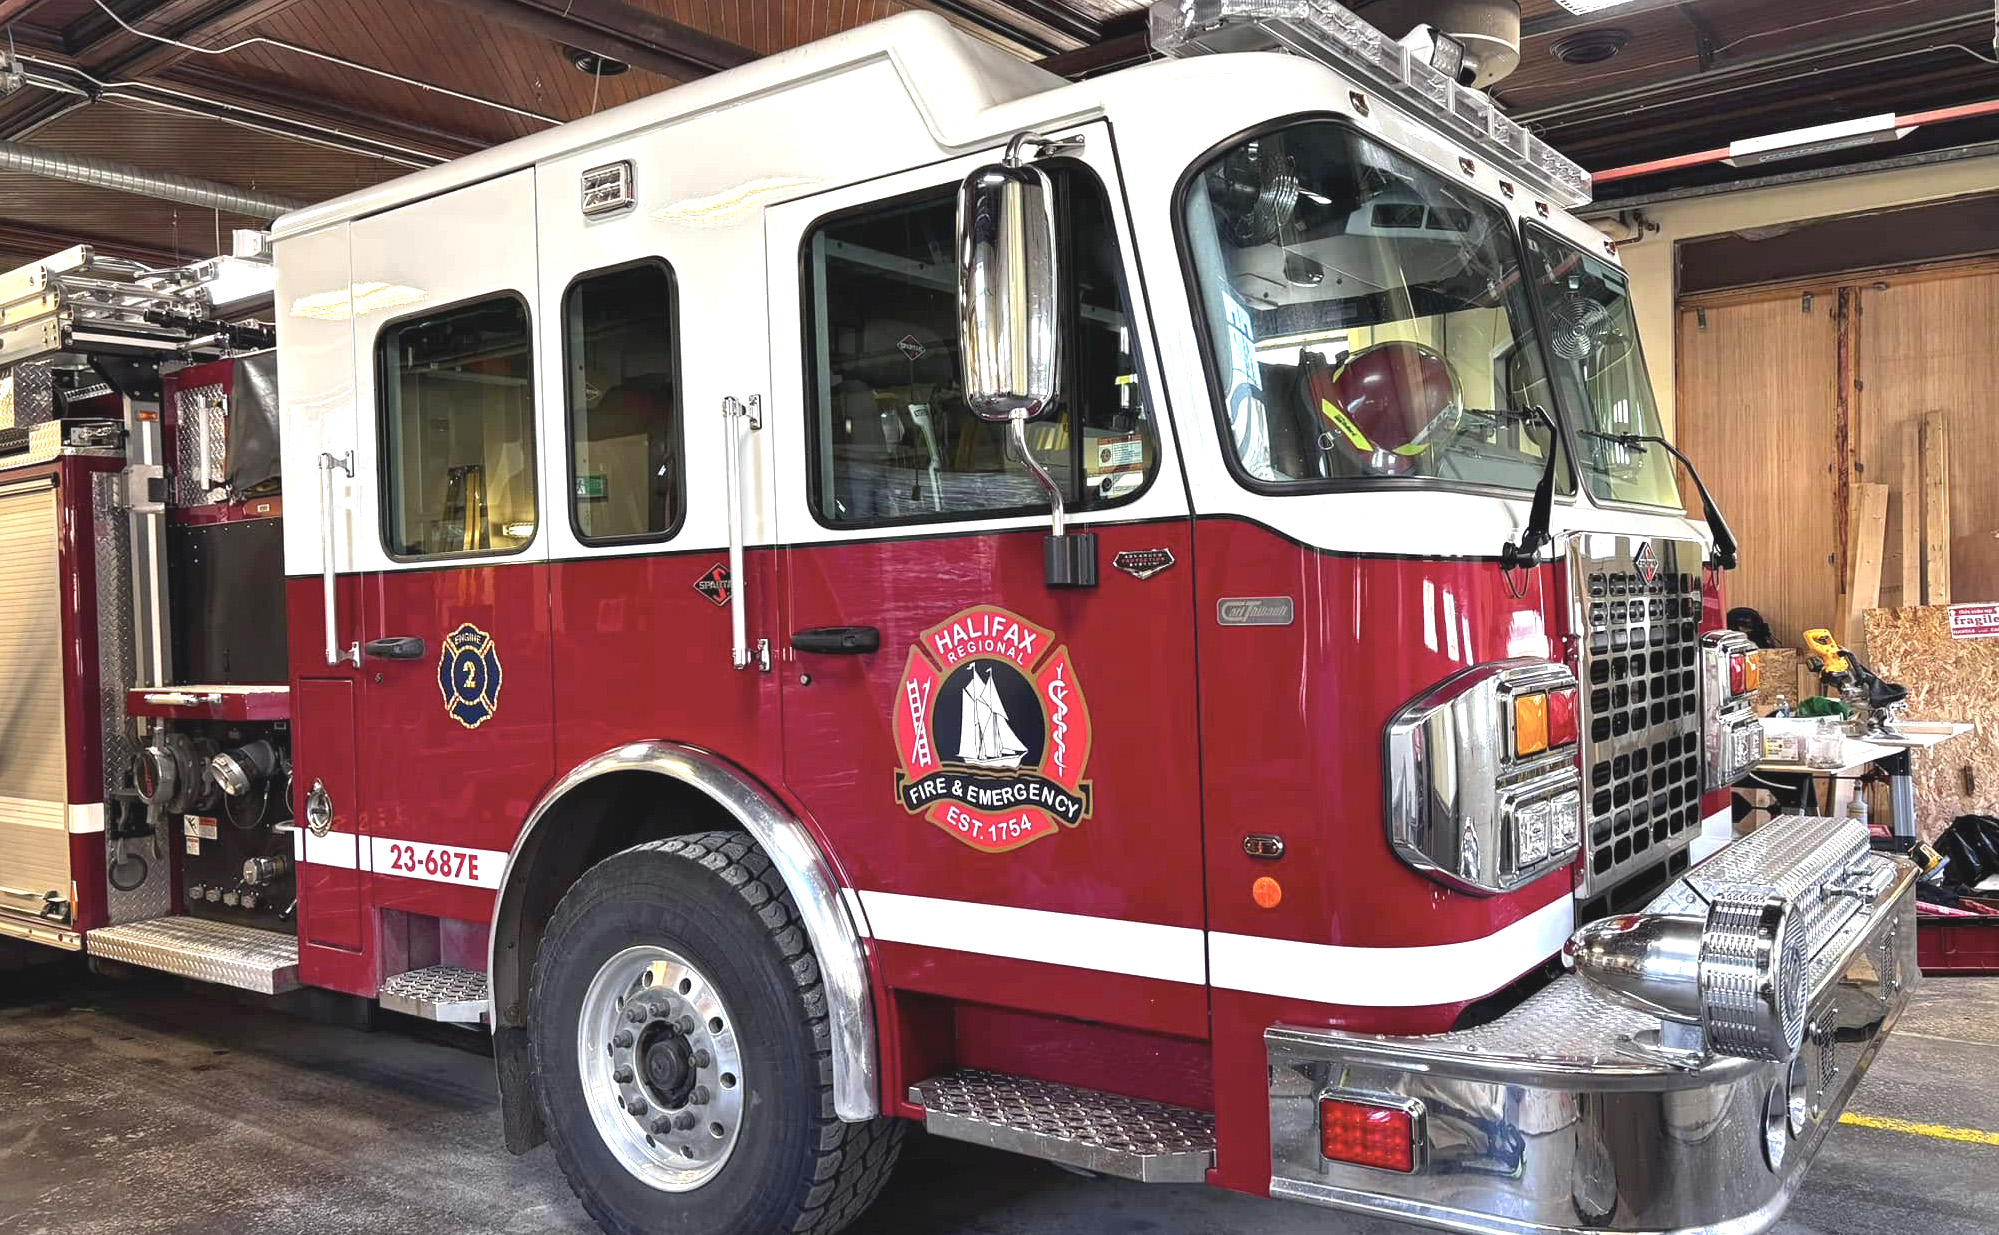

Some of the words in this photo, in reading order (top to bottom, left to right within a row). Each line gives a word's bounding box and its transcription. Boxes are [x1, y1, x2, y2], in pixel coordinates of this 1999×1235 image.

[454, 632, 482, 645] ENGINE
[934, 614, 1037, 654] HALIFAX
[947, 639, 1024, 665] REGIONAL
[462, 660, 476, 688] 2
[909, 777, 947, 804] FIRE
[951, 778, 964, 797] &
[967, 783, 1079, 819] EMERGENCY
[946, 806, 984, 840] EST.
[988, 813, 1032, 842] 1754
[390, 843, 479, 881] 23-687E
